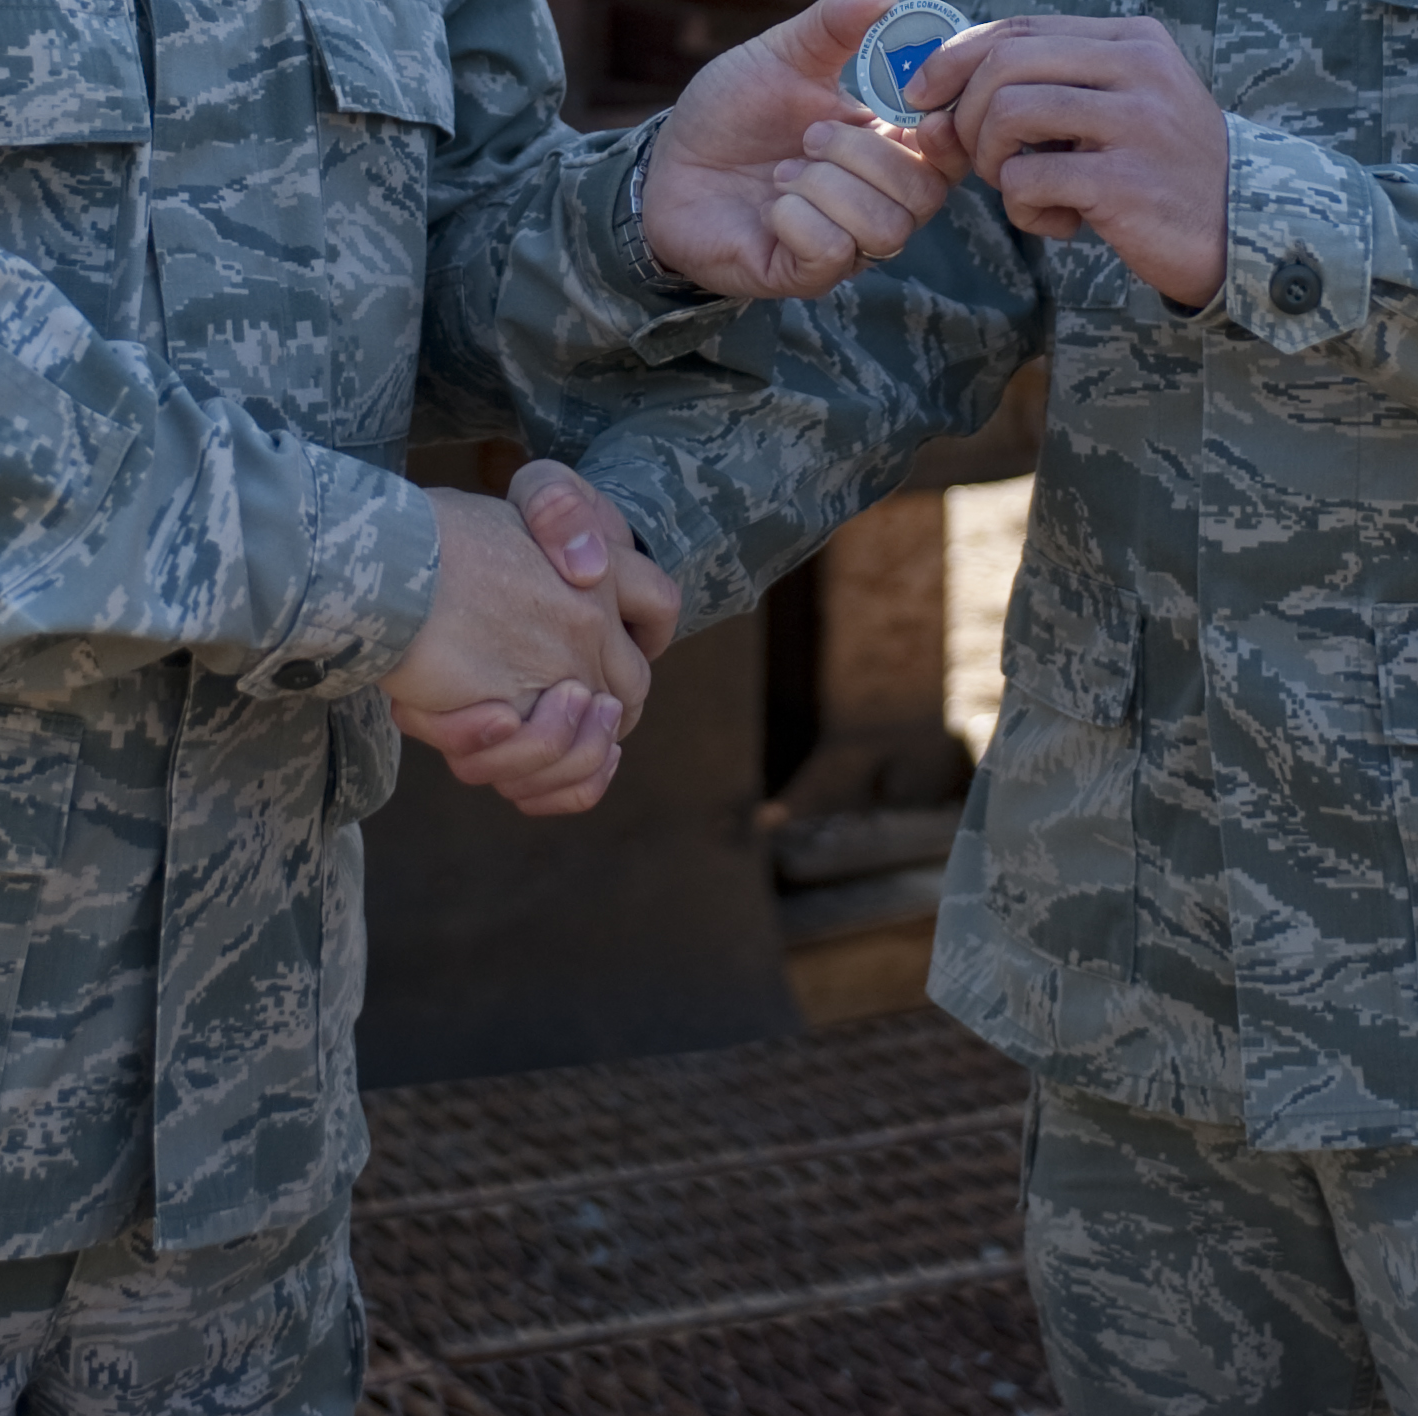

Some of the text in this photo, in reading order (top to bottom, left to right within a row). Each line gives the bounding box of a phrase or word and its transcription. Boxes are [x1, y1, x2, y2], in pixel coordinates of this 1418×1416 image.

[861, 0, 960, 60] PRESENTED BY THE COMMANDER
[893, 114, 917, 124] NINTH
